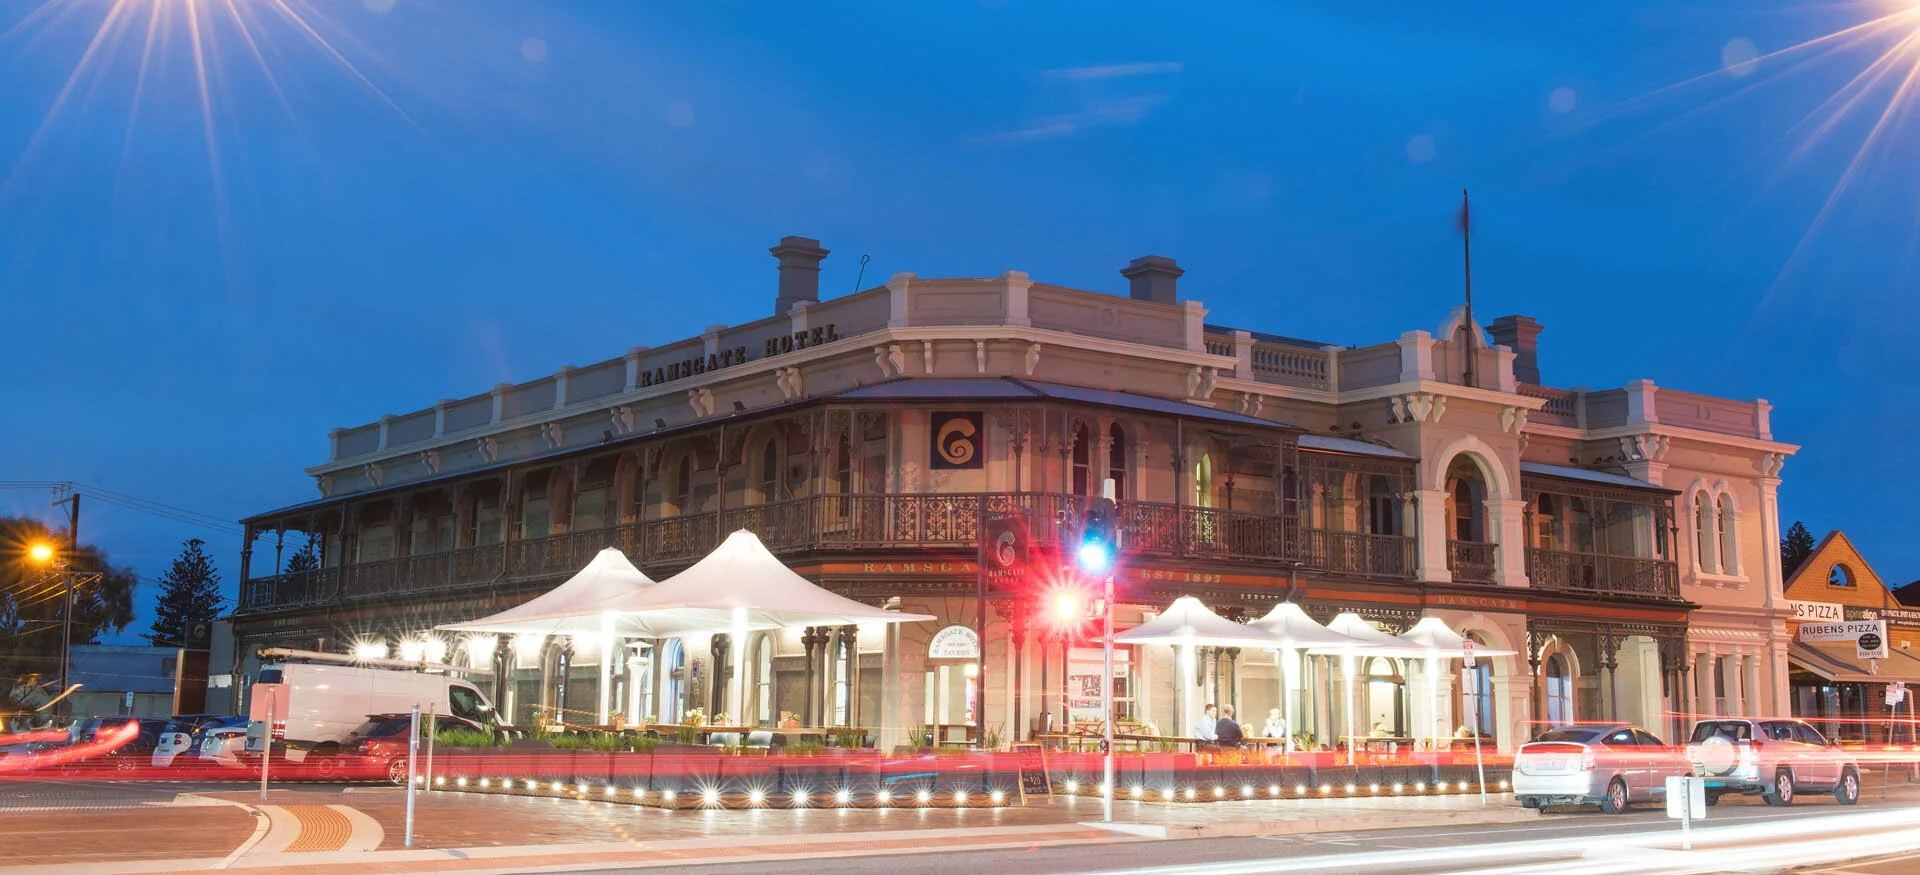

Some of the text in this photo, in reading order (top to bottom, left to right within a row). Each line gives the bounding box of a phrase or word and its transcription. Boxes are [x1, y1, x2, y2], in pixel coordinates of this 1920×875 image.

[640, 323, 839, 387] RAMSGATE HOTEL
[863, 562, 973, 573] RAMSGA
[1808, 604, 1839, 619] PIZZA
[1802, 624, 1879, 635] RUBENS PIZZA
